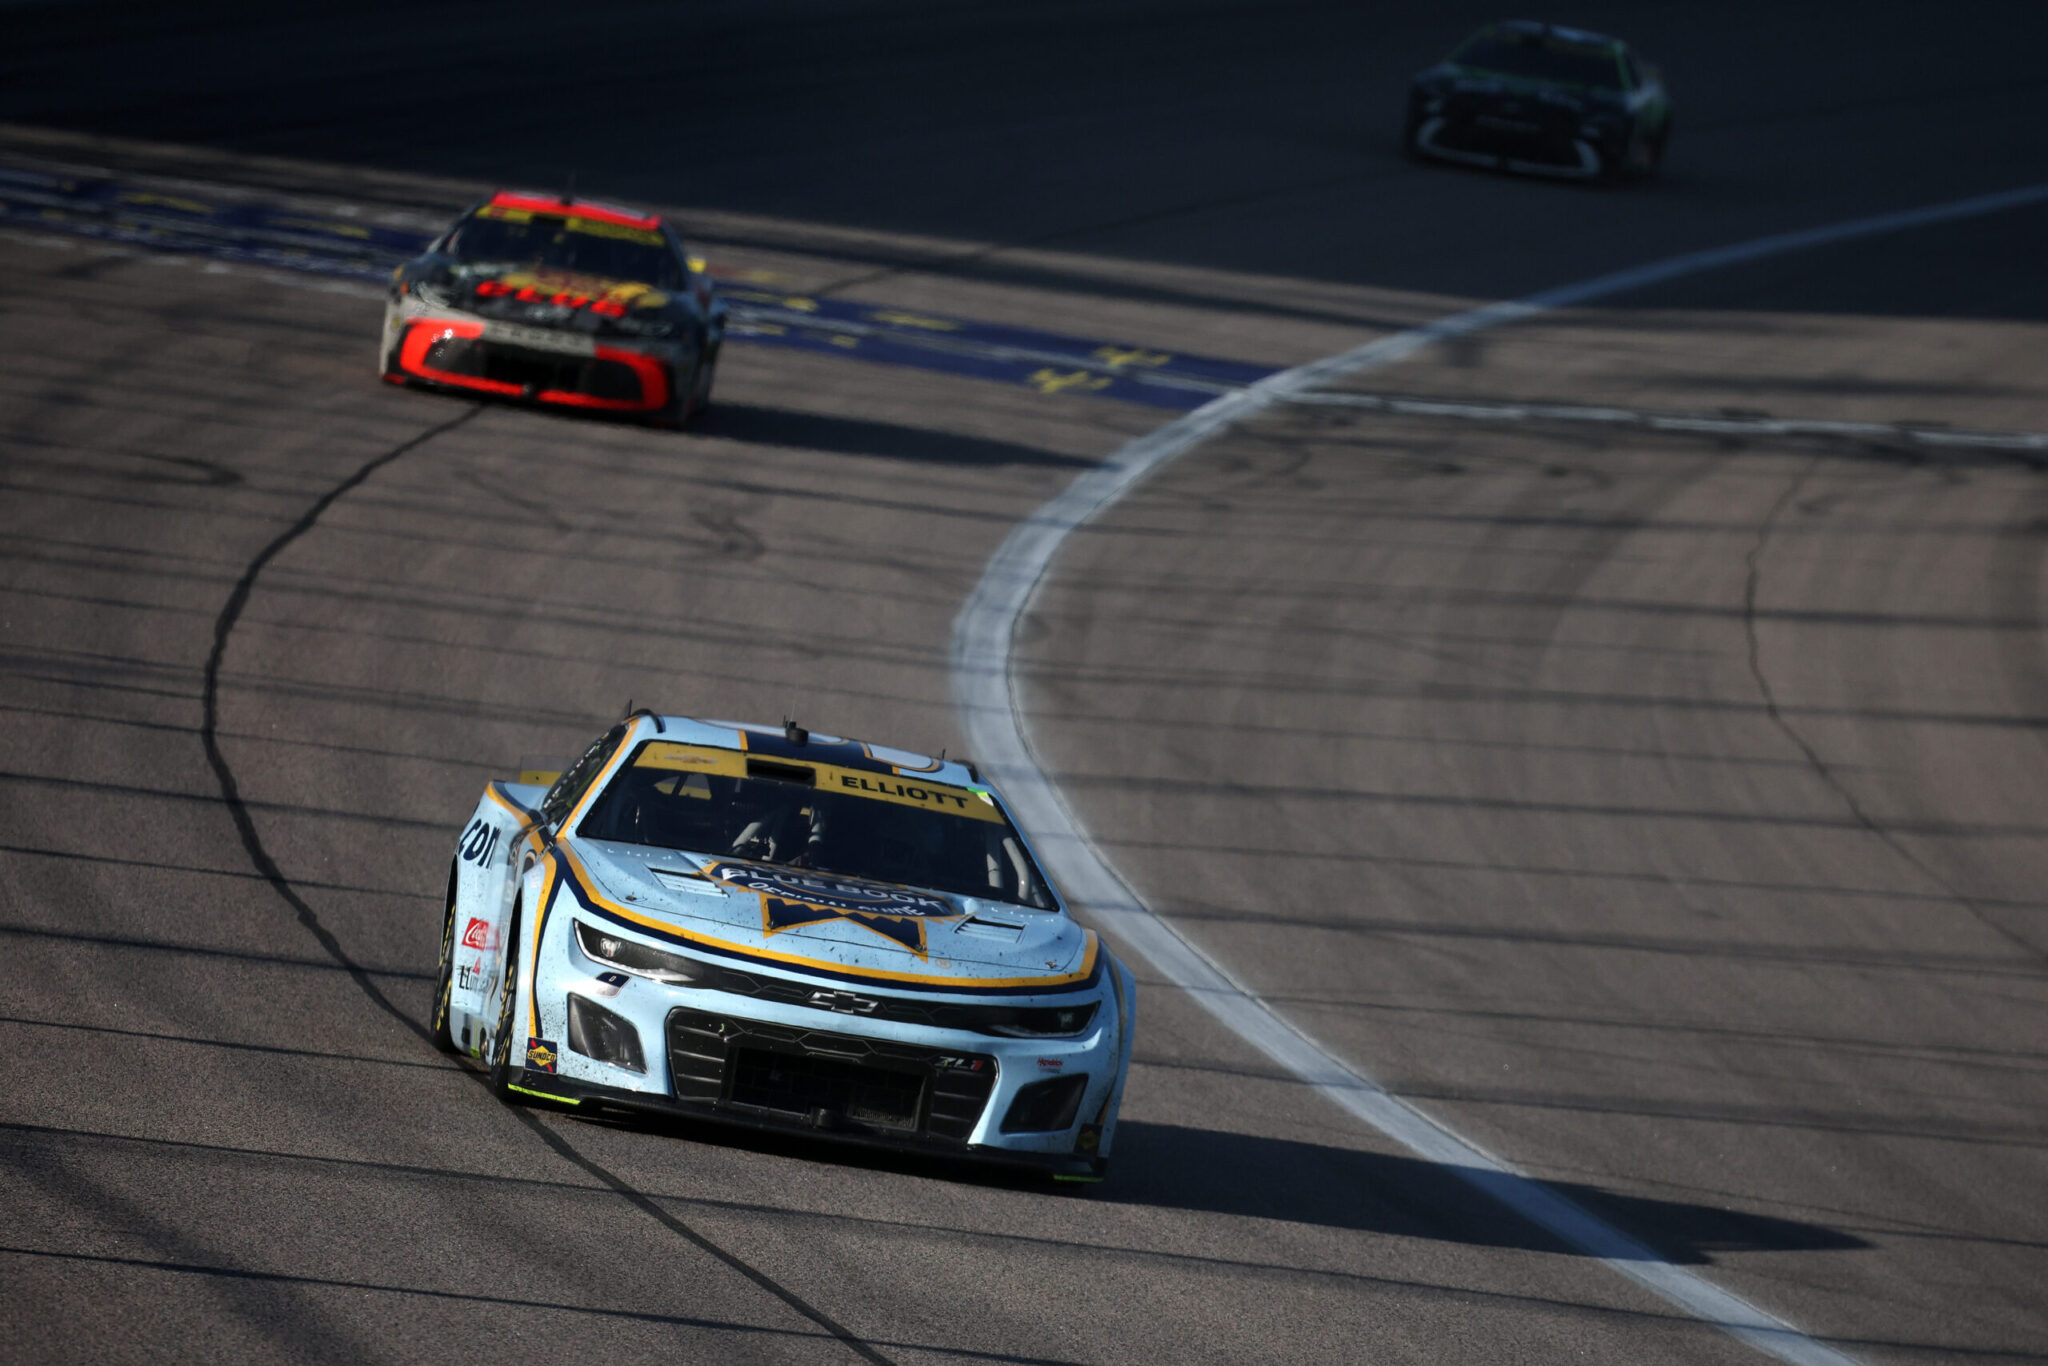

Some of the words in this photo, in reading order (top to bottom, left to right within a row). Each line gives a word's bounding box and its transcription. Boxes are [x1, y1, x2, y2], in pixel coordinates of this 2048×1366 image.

[841, 775, 968, 809] ELLIOTT
[721, 867, 826, 889] BLUE
[835, 883, 940, 908] BOOK
[528, 1050, 556, 1063] SUNOCO
